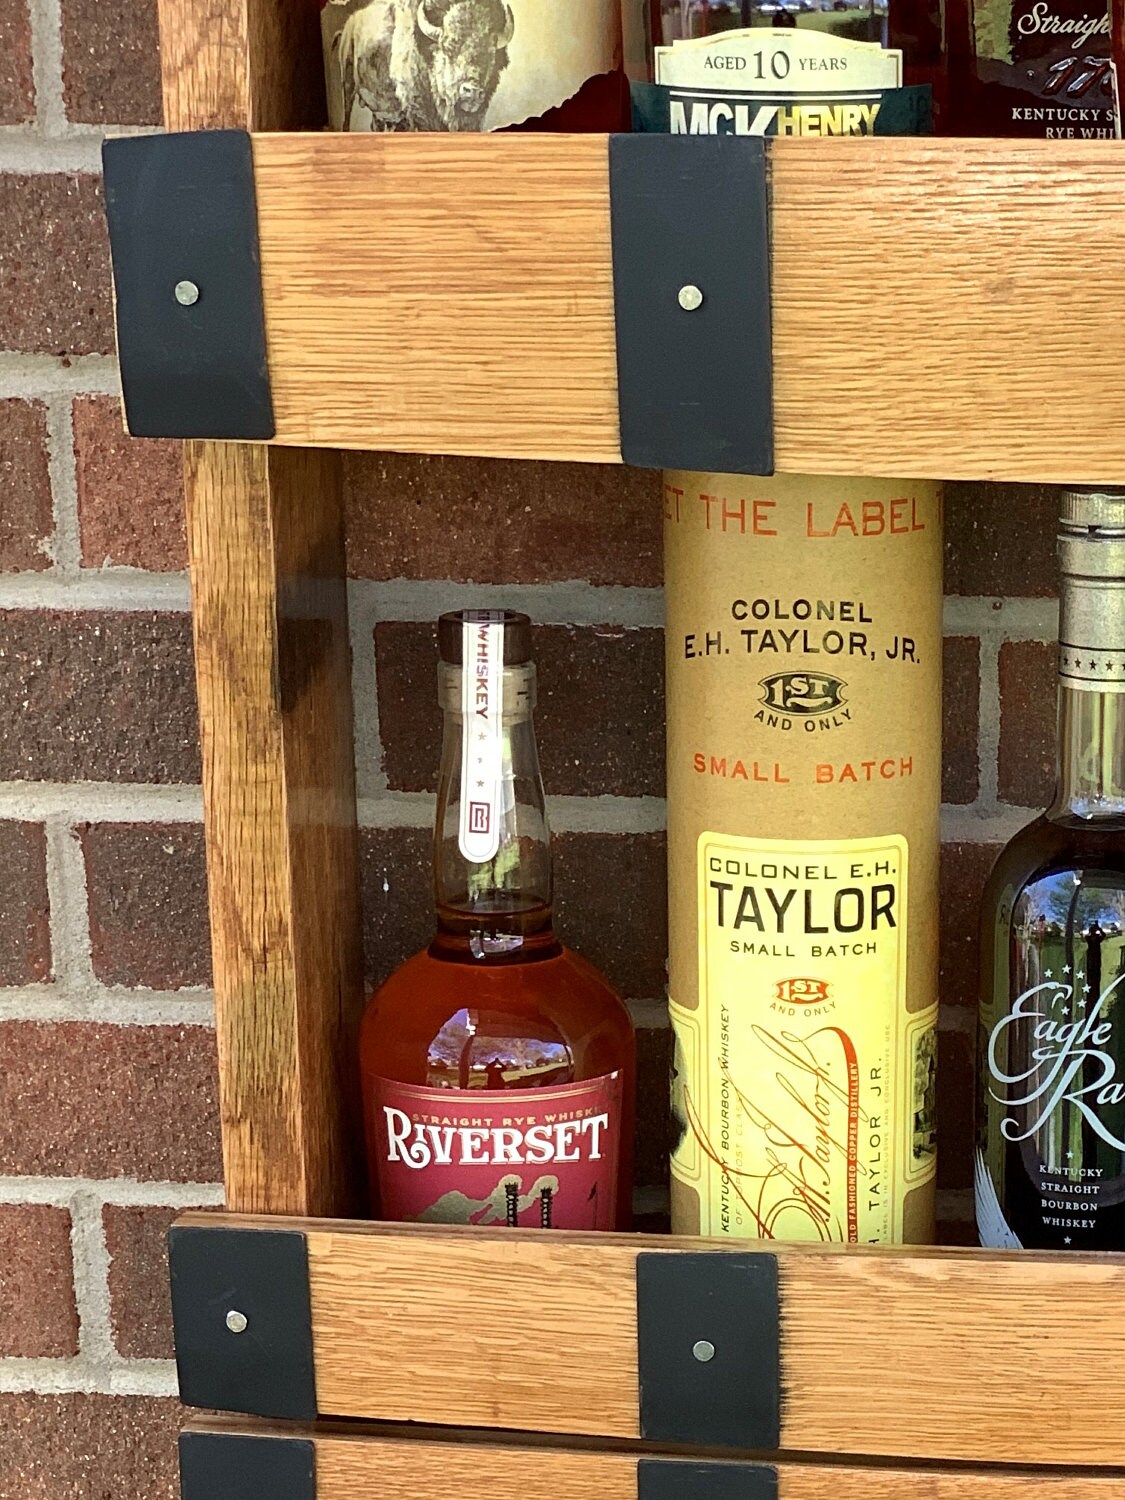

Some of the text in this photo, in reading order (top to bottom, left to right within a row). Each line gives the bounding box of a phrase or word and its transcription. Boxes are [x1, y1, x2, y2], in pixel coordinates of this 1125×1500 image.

[704, 50, 848, 79] AGED 10 YEARS
[1012, 107, 1101, 121] KENTUCKY
[1046, 127, 1075, 139] RYE
[699, 493, 777, 536] THE
[807, 497, 925, 537] LABEL
[732, 599, 873, 623] COLONEL
[684, 629, 921, 663] E.H. TAYLOR, JR.
[475, 623, 490, 719] WHISKEY
[754, 708, 853, 733] AND ONLY
[693, 753, 913, 784] SMALL BATCH
[709, 857, 897, 880] COLONEL E.H.
[709, 881, 898, 934] TAYLOR
[730, 940, 878, 957] SMALL BATCH
[769, 1001, 838, 1018] AND ONLY
[869, 1057, 882, 1097] JR.
[412, 1106, 605, 1127] STRAIGHT RYE WHISK
[719, 1003, 731, 1232] KENTUCKY BOURBON WHISKEY
[848, 1062, 858, 1243] OLD FASHIONED COPPER DISTILLERY
[869, 1115, 882, 1212] TAYLOR
[1039, 1165, 1103, 1178] KENTUCKY
[1041, 1182, 1100, 1194] STRAIGHT
[1041, 1199, 1098, 1211] BOURBON
[1042, 1216, 1097, 1229] WHISKEY
